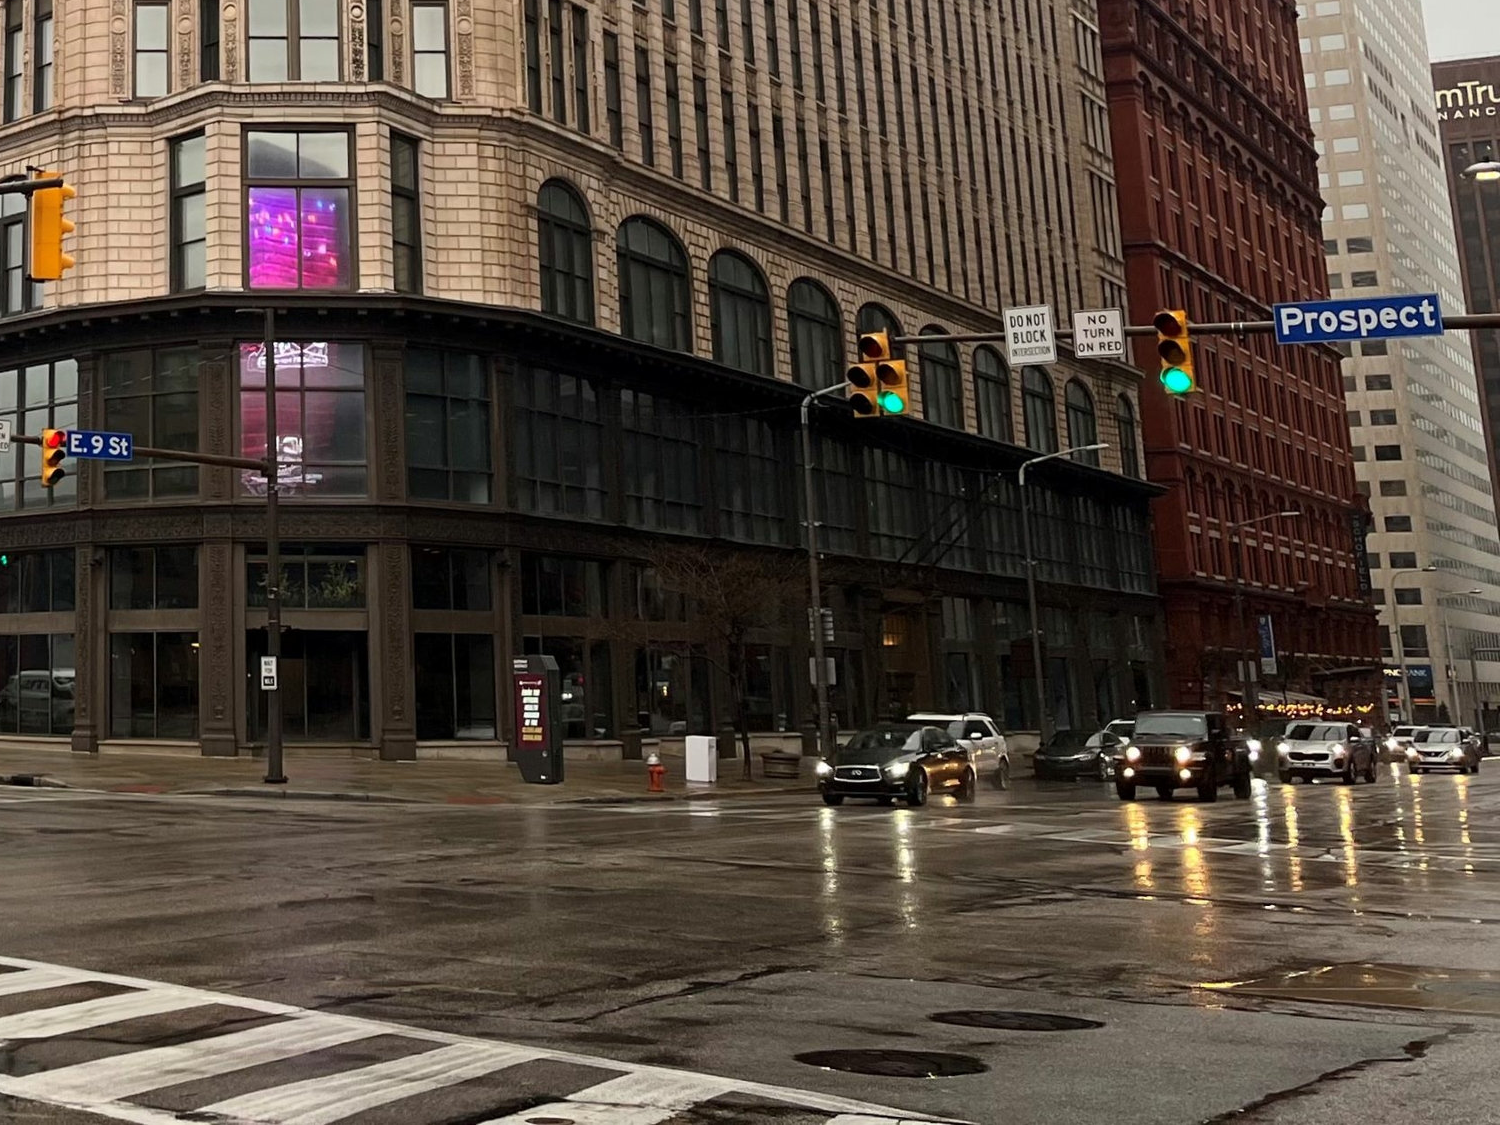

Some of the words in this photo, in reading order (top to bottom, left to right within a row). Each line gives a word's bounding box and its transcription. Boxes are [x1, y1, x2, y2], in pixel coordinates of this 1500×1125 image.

[1010, 315, 1024, 328] DO
[1026, 313, 1046, 327] NOT
[1087, 314, 1107, 326] NO
[1280, 298, 1436, 337] Prospect
[1013, 329, 1047, 344] BLOCK
[1082, 327, 1115, 339] TURN
[1012, 346, 1051, 357] INTERSECTION
[1078, 342, 1094, 353] ON
[1099, 341, 1122, 351] RED
[70, 433, 88, 453] E.
[91, 435, 104, 454] 9
[108, 437, 129, 456] St
